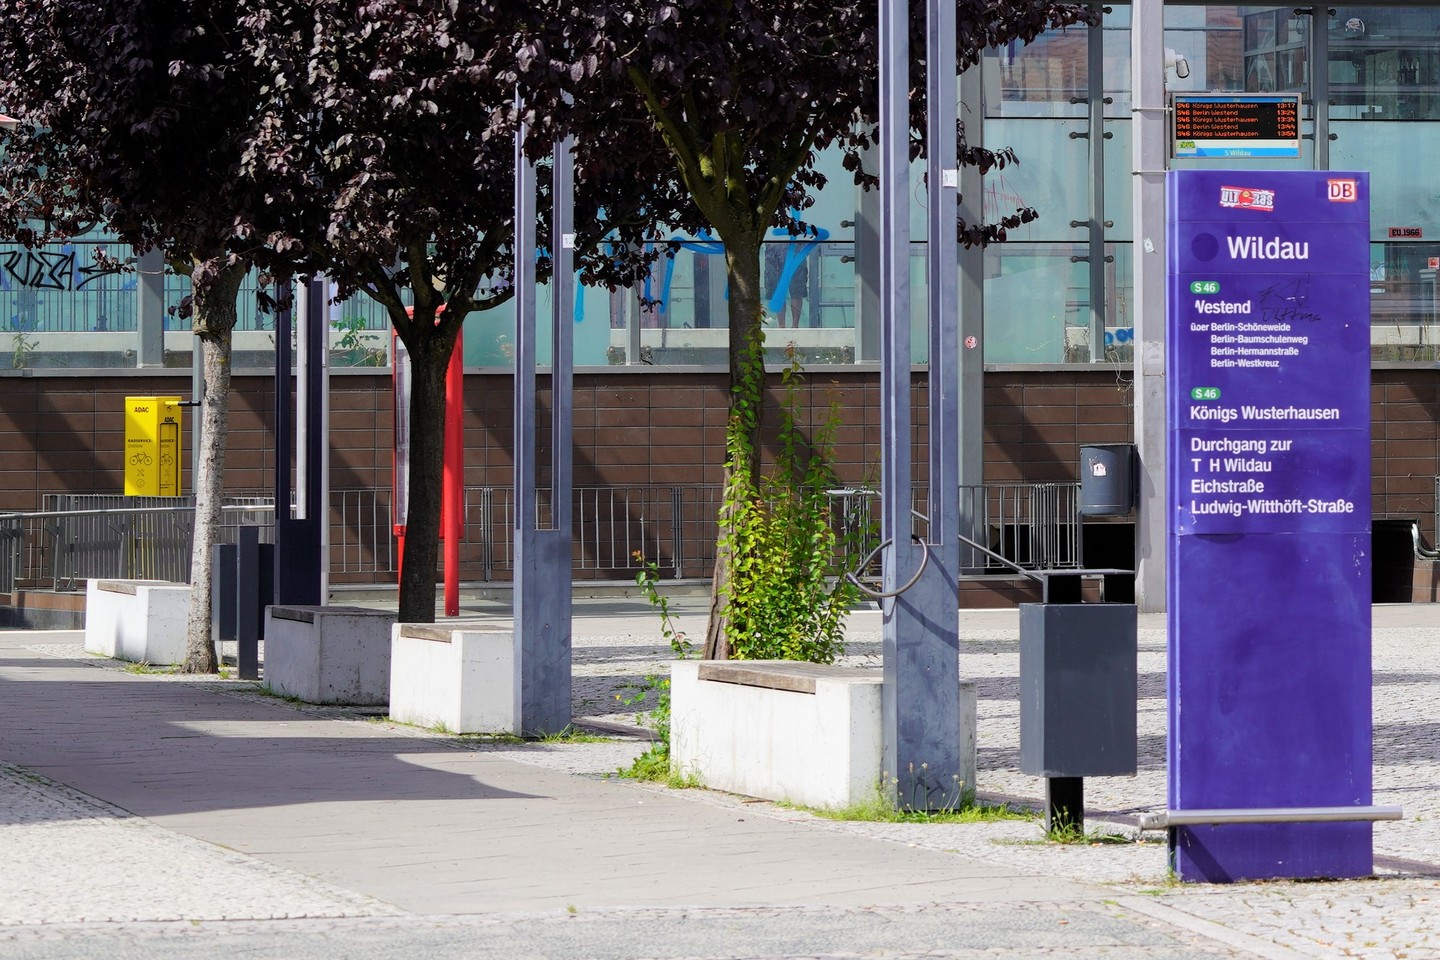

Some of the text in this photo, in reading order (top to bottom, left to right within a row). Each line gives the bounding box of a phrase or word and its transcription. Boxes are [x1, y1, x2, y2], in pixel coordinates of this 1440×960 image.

[1330, 182, 1353, 199] DB
[1227, 236, 1309, 259] Wildau
[1194, 283, 1216, 292] S 46
[1211, 322, 1291, 332] Berlin-Schöneweide
[1210, 335, 1308, 345] Berlin-Baumschulenweg
[1210, 347, 1299, 356] Berlin-Hermannstraße
[1210, 359, 1280, 368] Berlin-Westkreuz
[1195, 389, 1216, 398] S 46
[1190, 406, 1340, 422] Königs Wusterhausen
[1191, 437, 1292, 454] Durchgang zur
[1224, 458, 1272, 472] Wildau
[1191, 479, 1264, 493] Eichstraße
[1191, 499, 1354, 516] Ludwig-Witthöft-Straße
